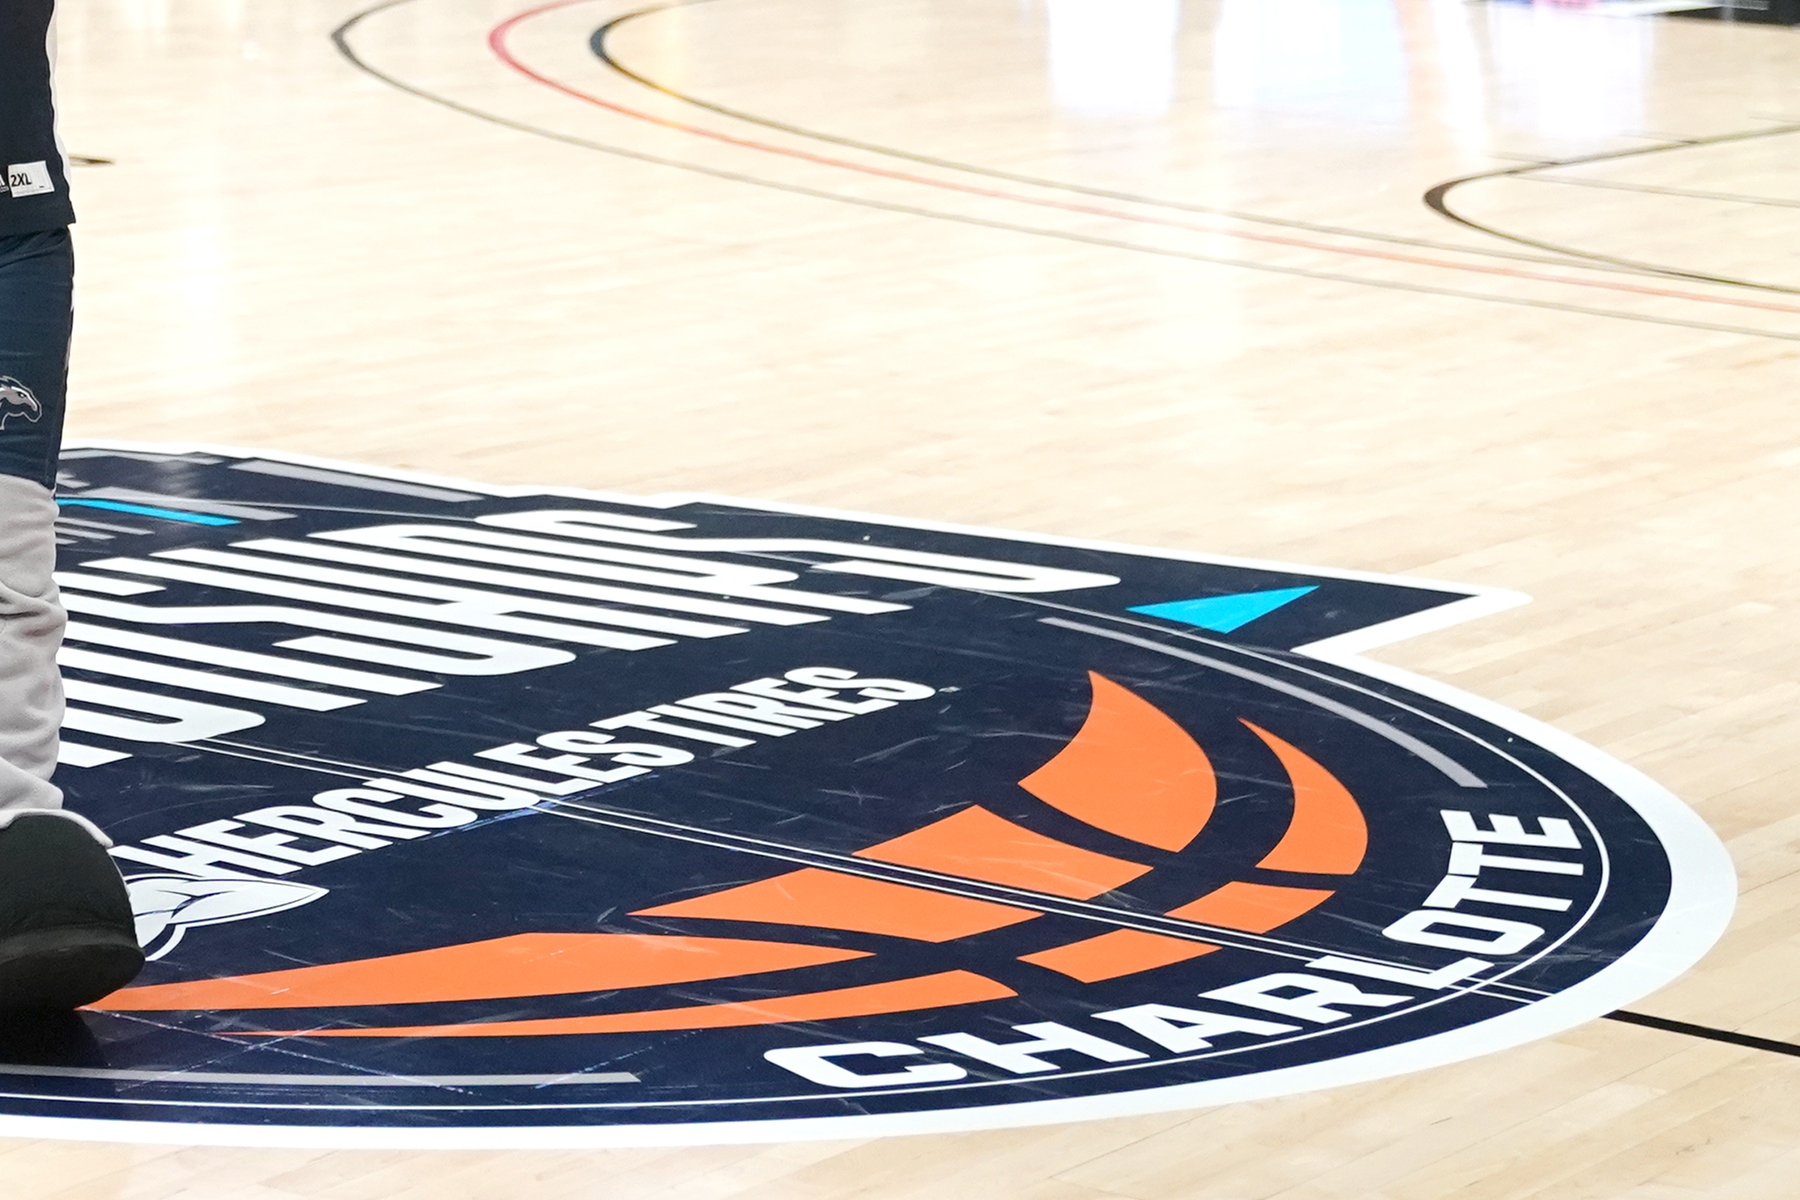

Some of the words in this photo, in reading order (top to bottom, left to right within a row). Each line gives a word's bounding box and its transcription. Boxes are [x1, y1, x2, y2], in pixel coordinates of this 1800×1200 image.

[10, 172, 33, 187] 2XL
[109, 729, 696, 880] HERCULES
[590, 666, 937, 750] TIRES
[762, 808, 1584, 1089] CHARLOTTE
